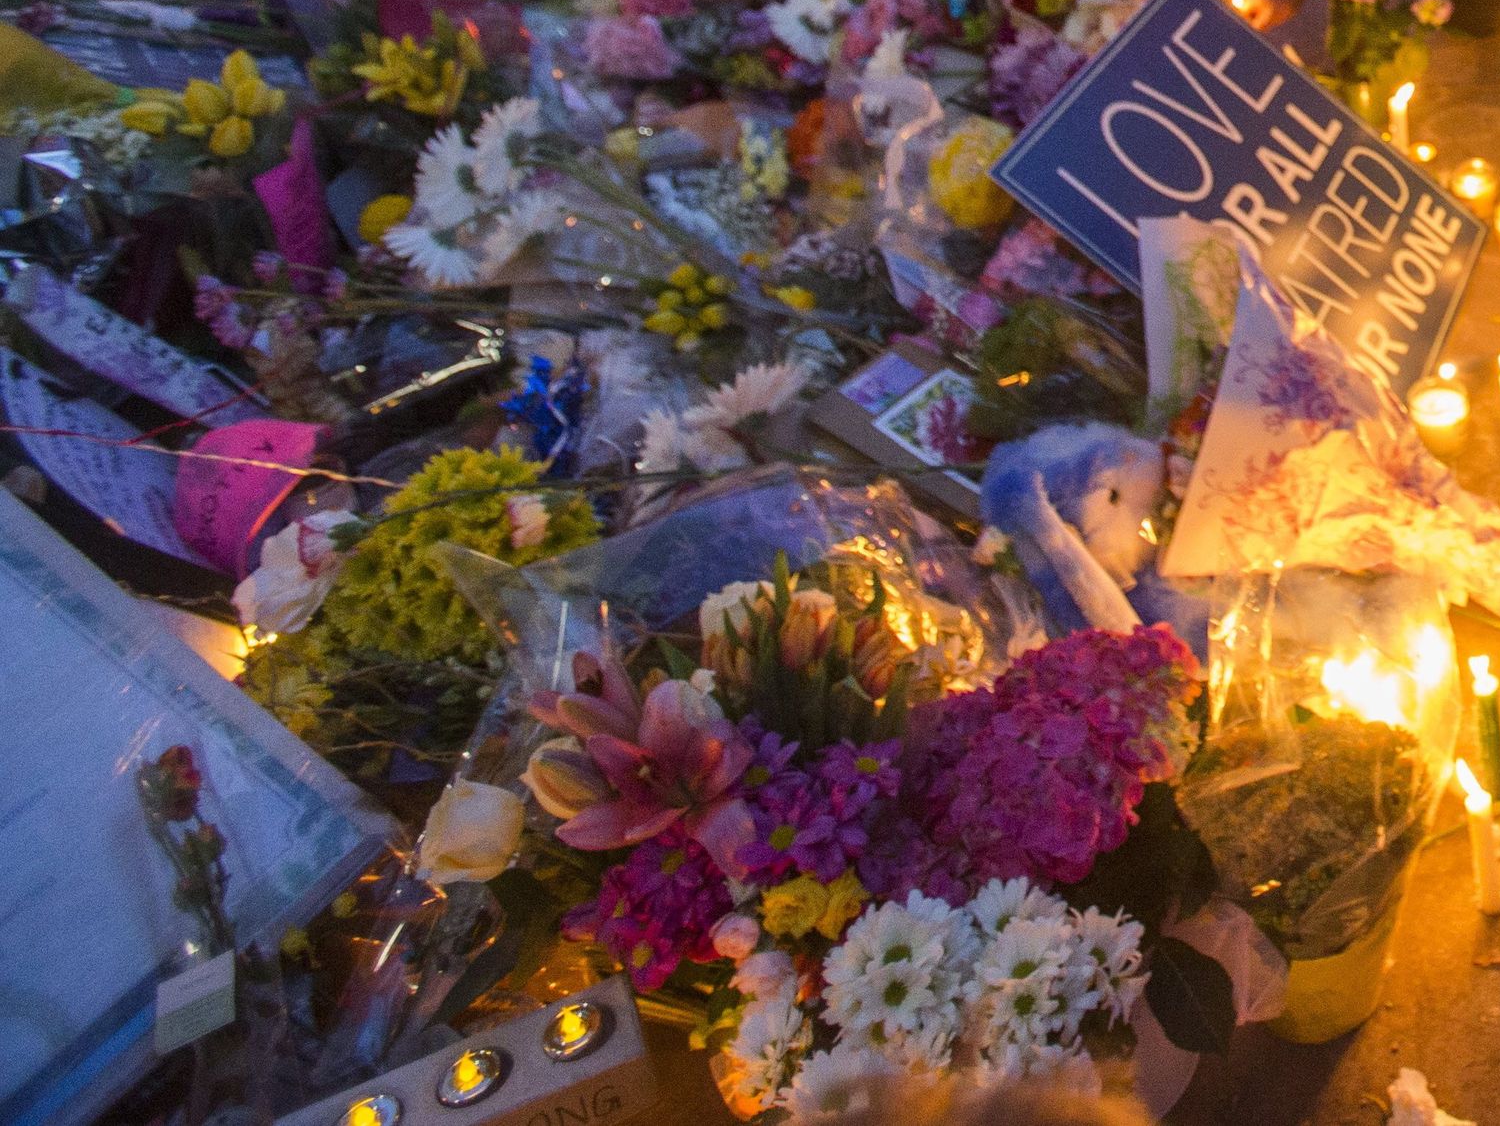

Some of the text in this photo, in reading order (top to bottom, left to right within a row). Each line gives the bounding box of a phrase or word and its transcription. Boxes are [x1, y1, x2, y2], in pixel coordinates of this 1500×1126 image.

[1205, 103, 1344, 266] OR ALL
[1279, 145, 1410, 326] ATRED
[1376, 193, 1463, 331] NONE
